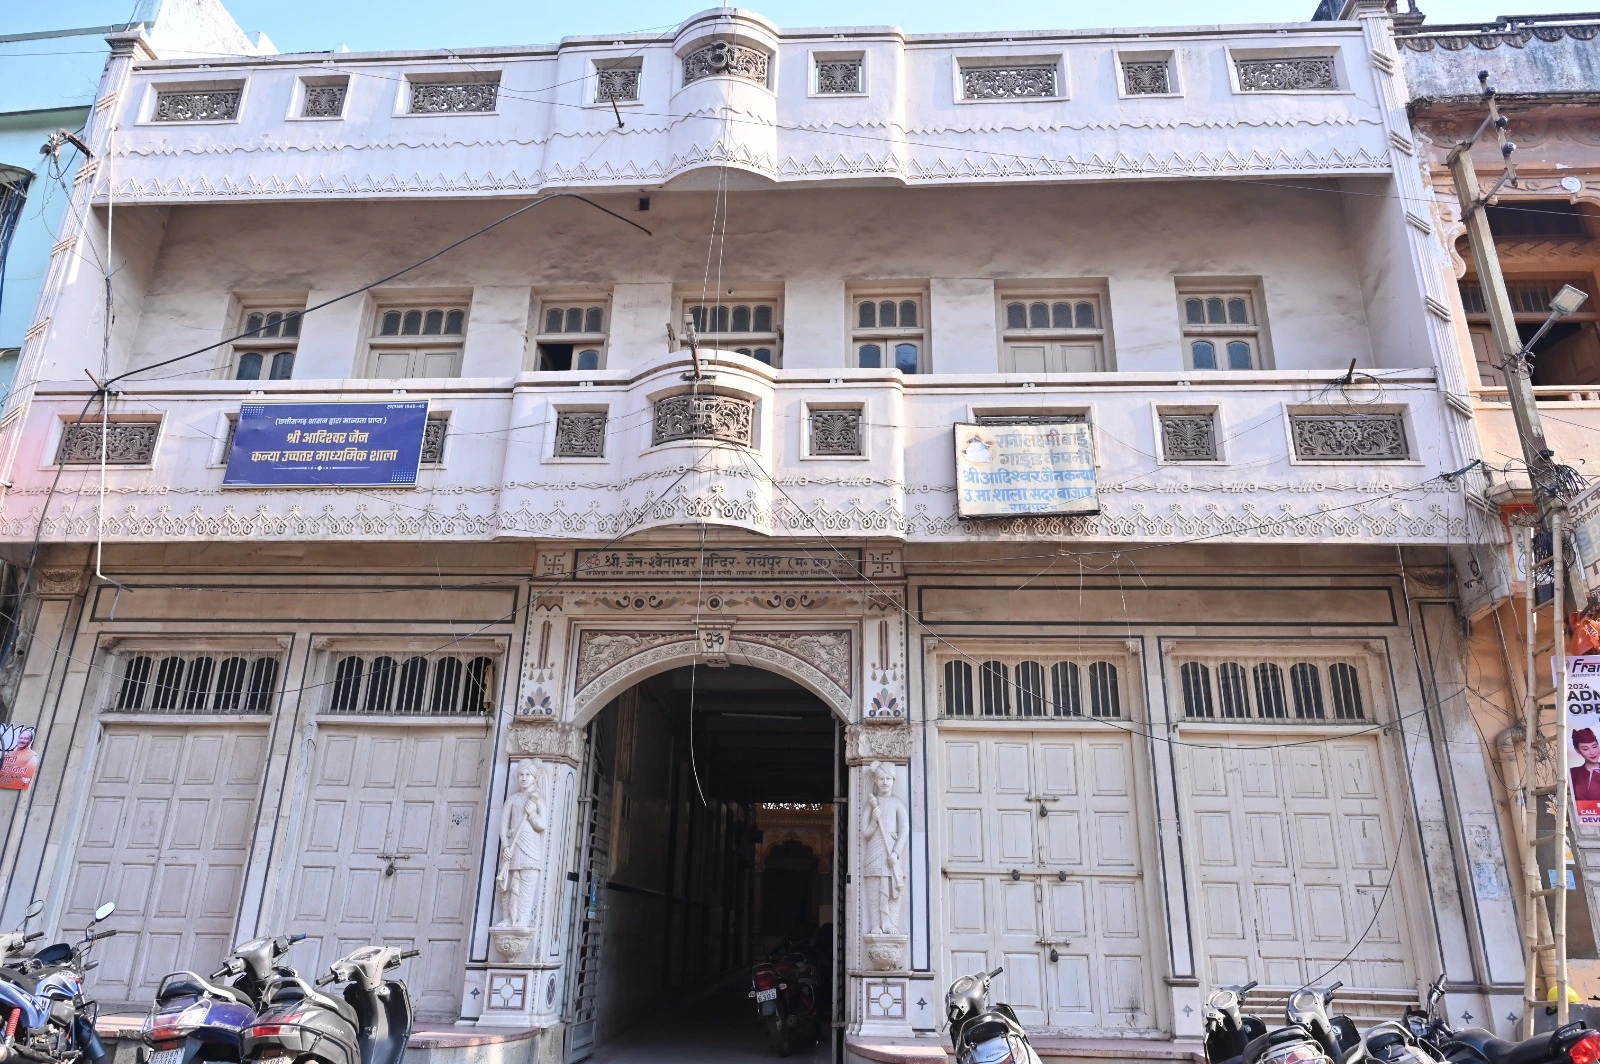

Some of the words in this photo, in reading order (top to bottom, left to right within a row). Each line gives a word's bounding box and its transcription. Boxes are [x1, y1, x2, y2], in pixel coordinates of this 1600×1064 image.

[308, 417, 328, 425] शासन
[328, 417, 342, 426] द्वारा
[342, 417, 366, 425] मान्यता
[286, 429, 301, 444] श्री
[302, 430, 347, 444] आदिश्वर
[348, 429, 370, 443] जैन
[251, 450, 280, 463] कन्या
[281, 450, 314, 462] उच्चतर
[314, 447, 369, 462] माध्यमिक
[369, 449, 398, 461] शाला
[963, 467, 980, 484] श्री
[1041, 466, 1065, 483] जैन
[1064, 469, 1096, 483] कन्या
[1029, 487, 1058, 502] सदर
